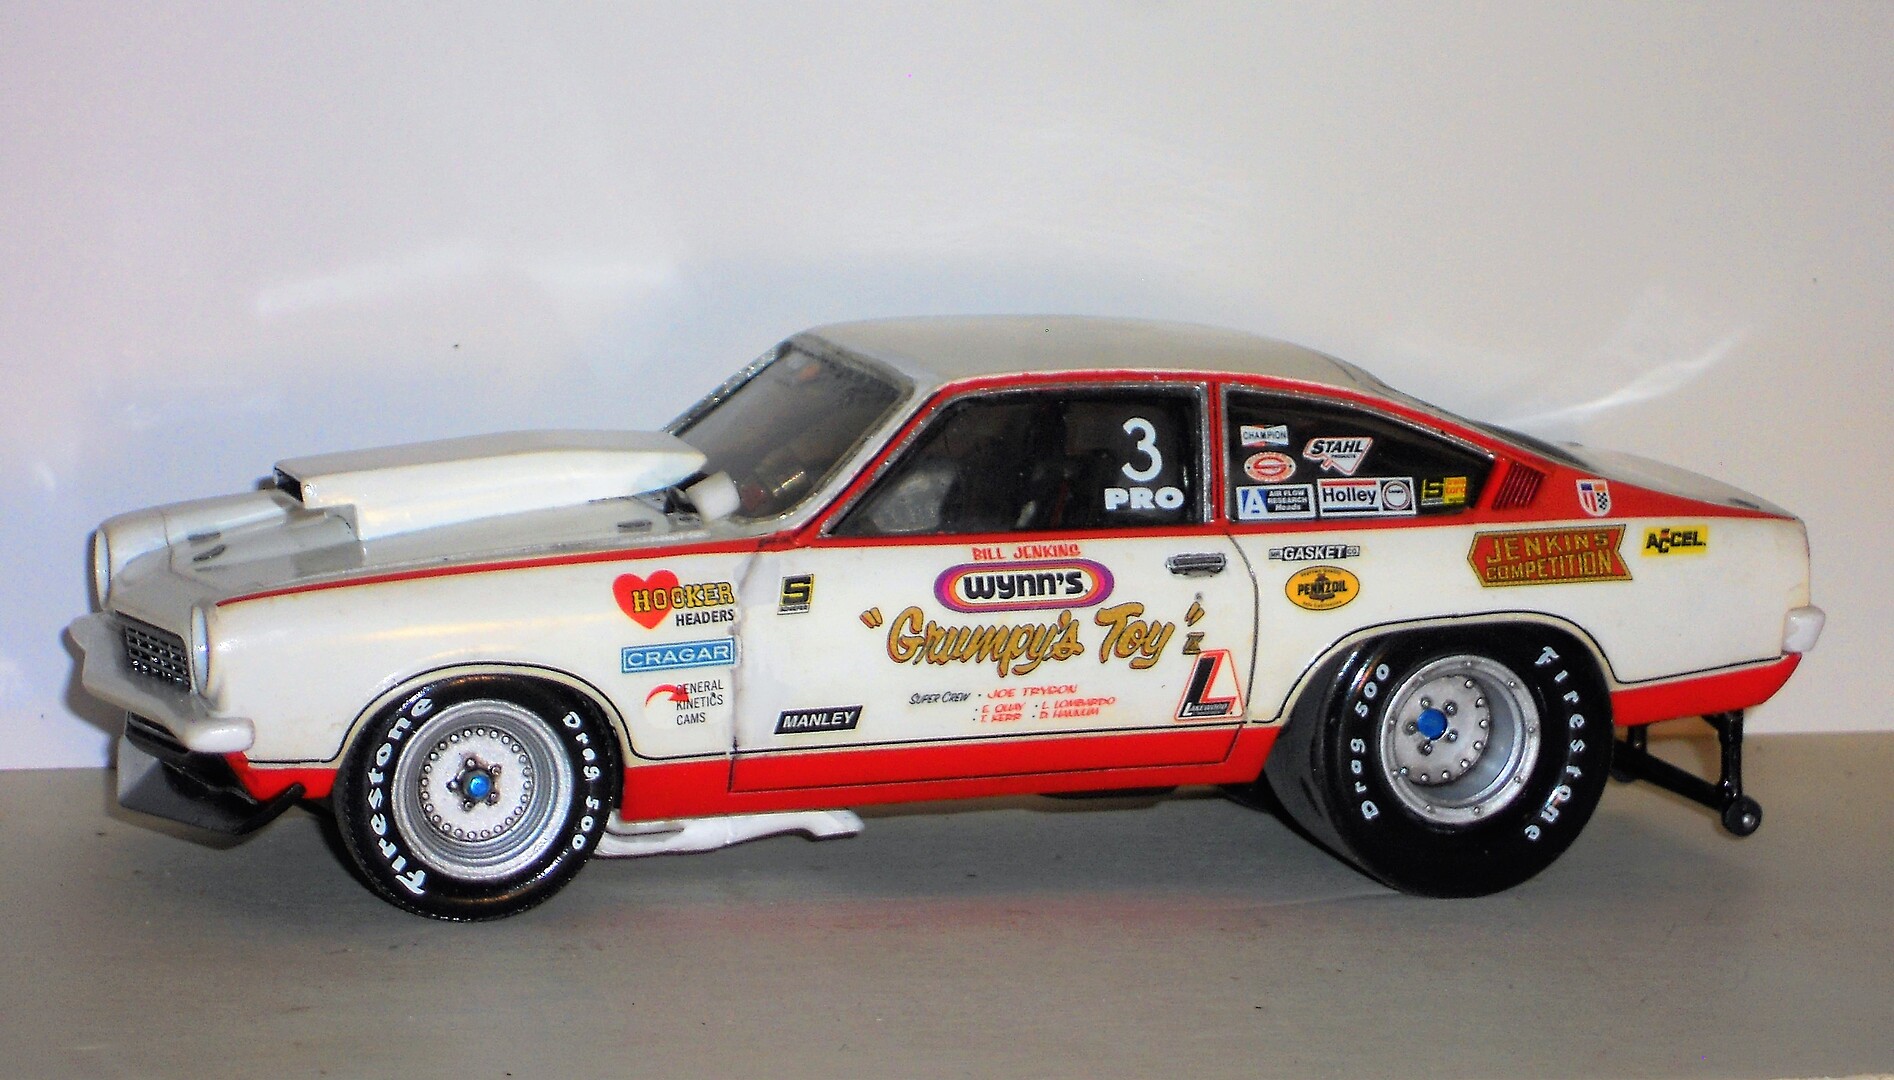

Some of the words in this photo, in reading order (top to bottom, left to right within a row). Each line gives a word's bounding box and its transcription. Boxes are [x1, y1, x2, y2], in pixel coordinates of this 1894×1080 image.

[1243, 430, 1287, 440] CHAMPION
[1122, 418, 1162, 481] 3
[1311, 439, 1363, 455] STAHL
[1104, 486, 1184, 510] PRO
[1322, 486, 1377, 505] Holley
[971, 546, 1006, 561] BILL
[1283, 545, 1346, 560] GASKET
[1486, 532, 1609, 564] JENKINS
[1486, 549, 1613, 581] COMPETITION
[632, 582, 735, 614] HOOKER
[676, 609, 734, 627] HEADERS
[627, 645, 729, 668] CRAGAR
[675, 679, 724, 695] GENERAL
[986, 687, 1016, 699] JOE
[1355, 663, 1390, 718] 500
[676, 694, 724, 711] KINETICS
[676, 713, 706, 726] CAMS
[782, 710, 856, 729] MANLEY
[562, 711, 600, 782] Drag
[1524, 646, 1586, 841] Firestone
[1350, 738, 1379, 820] Drag
[368, 698, 432, 895] Firestone
[572, 796, 599, 850] 500
